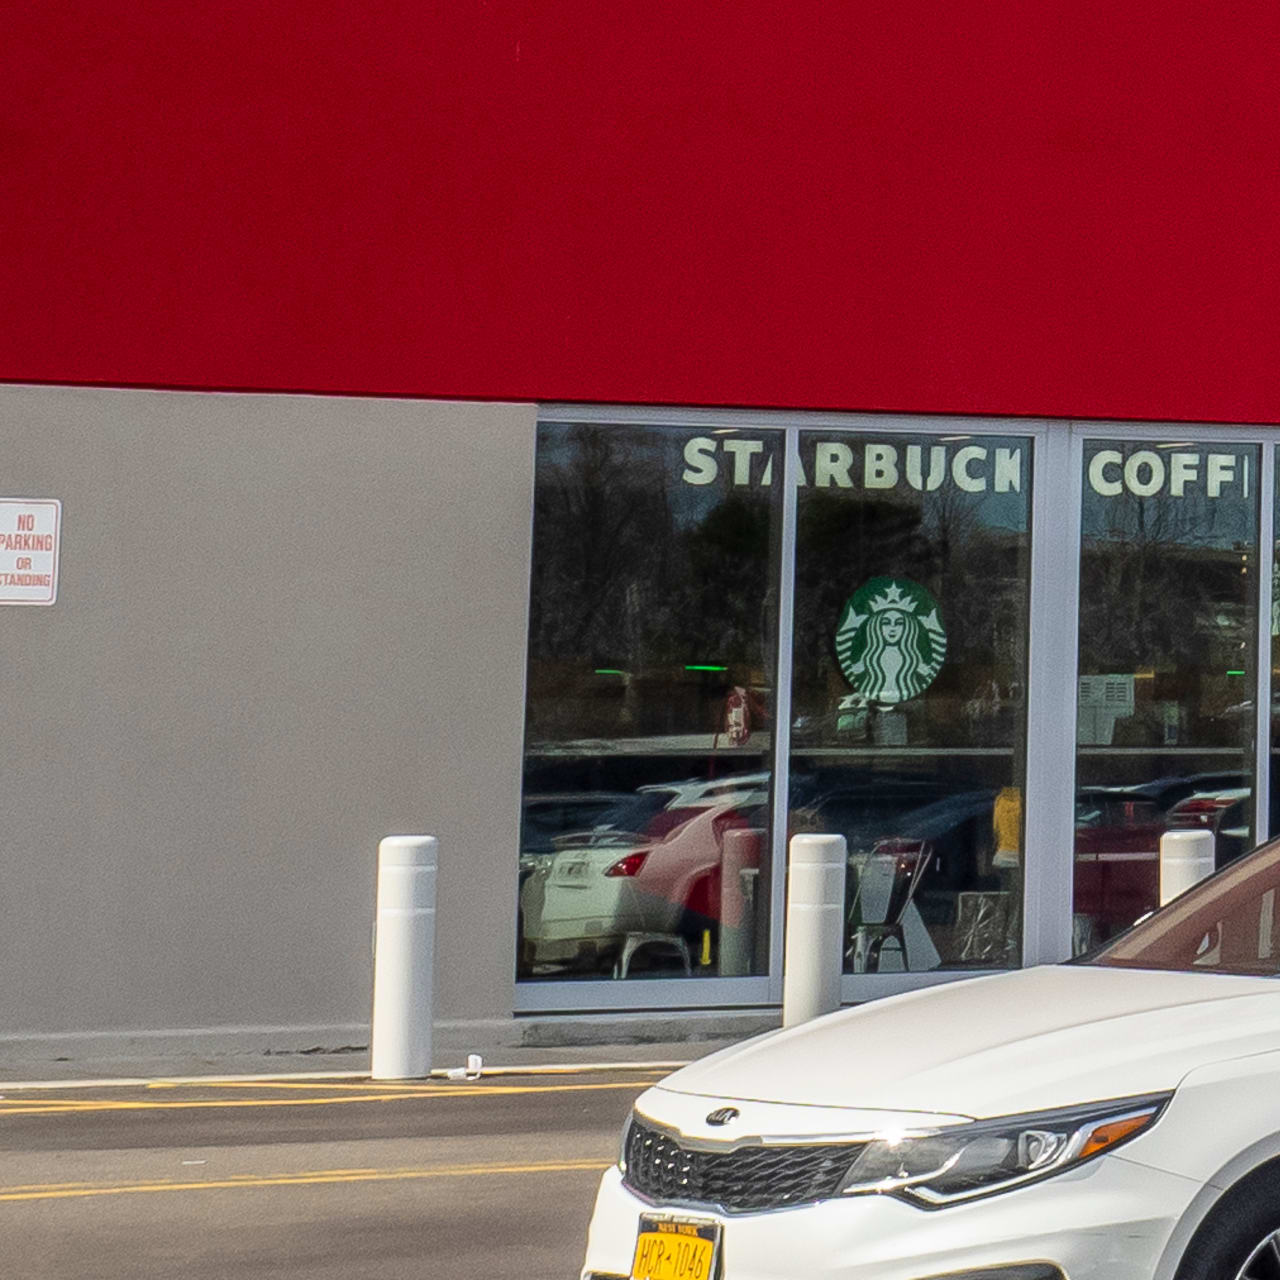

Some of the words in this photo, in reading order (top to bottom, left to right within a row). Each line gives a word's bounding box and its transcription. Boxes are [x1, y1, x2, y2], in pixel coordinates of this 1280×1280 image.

[17, 514, 35, 532] NO
[16, 557, 32, 570] OR
[0, 573, 51, 587] TANDING
[637, 1239, 665, 1275] HCR
[673, 1242, 707, 1279] 1046
